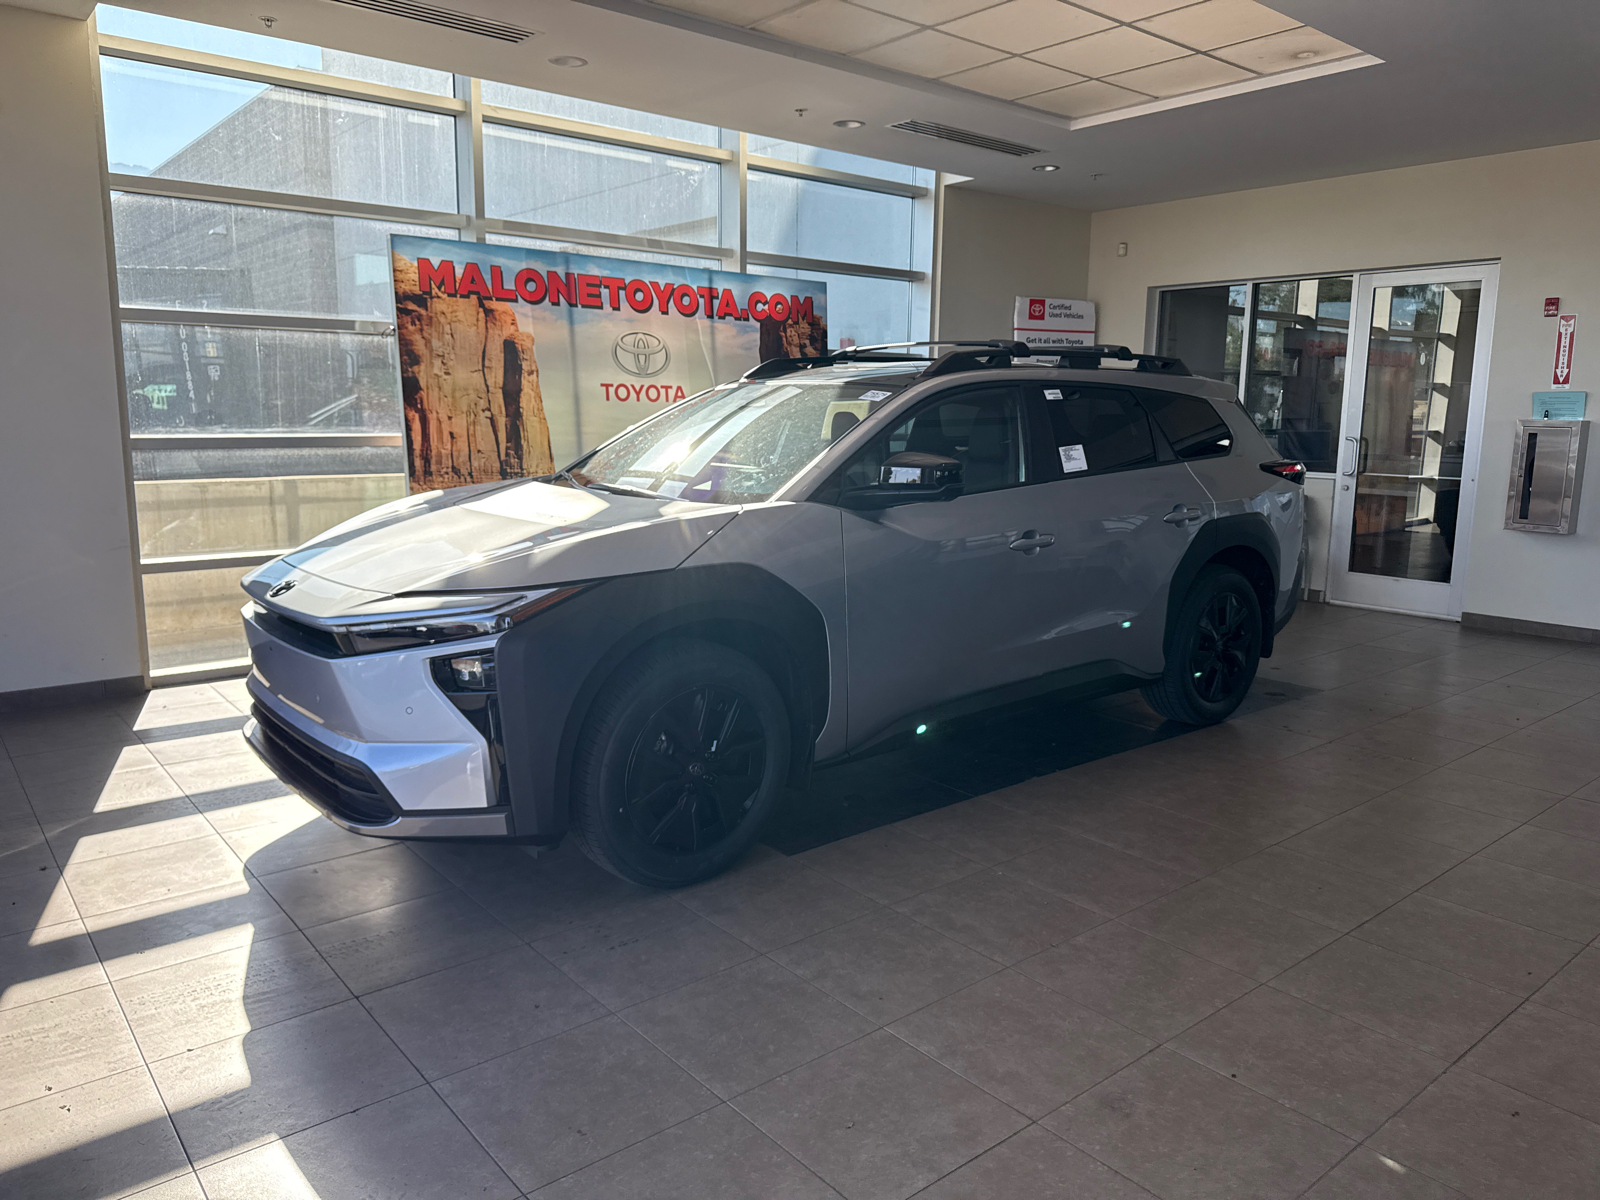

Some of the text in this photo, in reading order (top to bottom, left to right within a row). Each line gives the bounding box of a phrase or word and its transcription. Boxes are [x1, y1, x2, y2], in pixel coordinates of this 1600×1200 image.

[417, 257, 814, 324] MALONETOYOTA.COM
[1049, 303, 1072, 311] Certified
[1065, 338, 1084, 346] Toyota
[1560, 328, 1568, 378] EXTINGUISHER
[601, 383, 686, 403] TOYOTA
